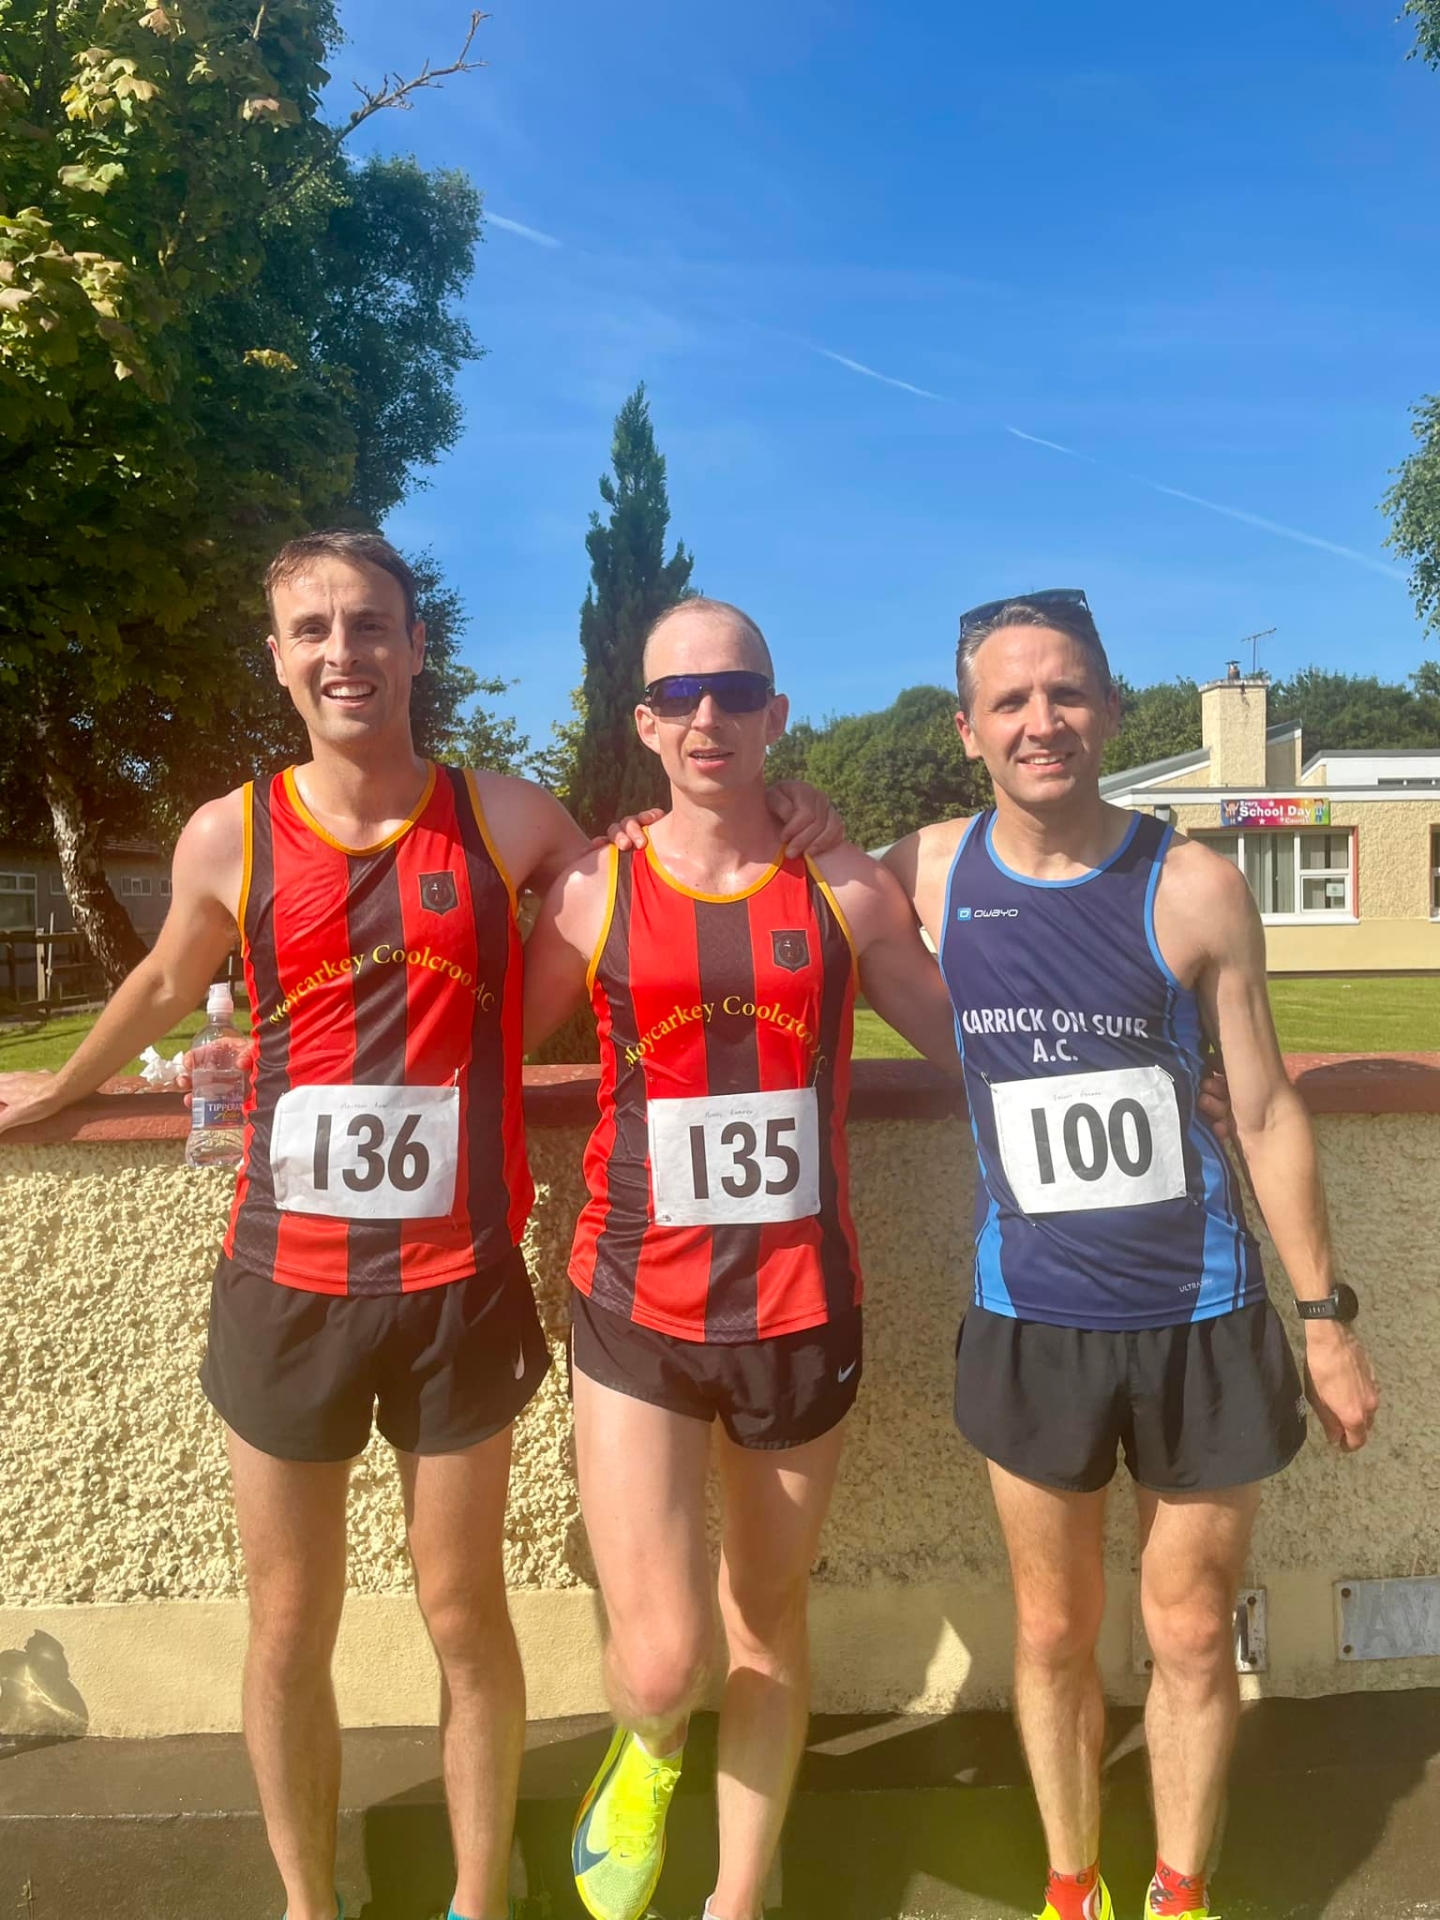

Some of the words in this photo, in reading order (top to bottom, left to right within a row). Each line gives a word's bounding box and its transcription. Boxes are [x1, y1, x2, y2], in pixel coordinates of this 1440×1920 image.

[1240, 806, 1283, 816] School
[1288, 806, 1312, 817] Day
[269, 954, 365, 1026] Moycarkey
[372, 944, 472, 986] Coolcroo
[471, 982, 495, 1012] AC
[962, 1008, 1047, 1034] CARRICK
[1052, 1009, 1088, 1033] ON
[1092, 1014, 1149, 1039] SUIR
[1033, 1038, 1079, 1063] A.C.
[313, 1113, 430, 1192] 136
[689, 1117, 801, 1200] 135
[1030, 1097, 1153, 1185] 100
